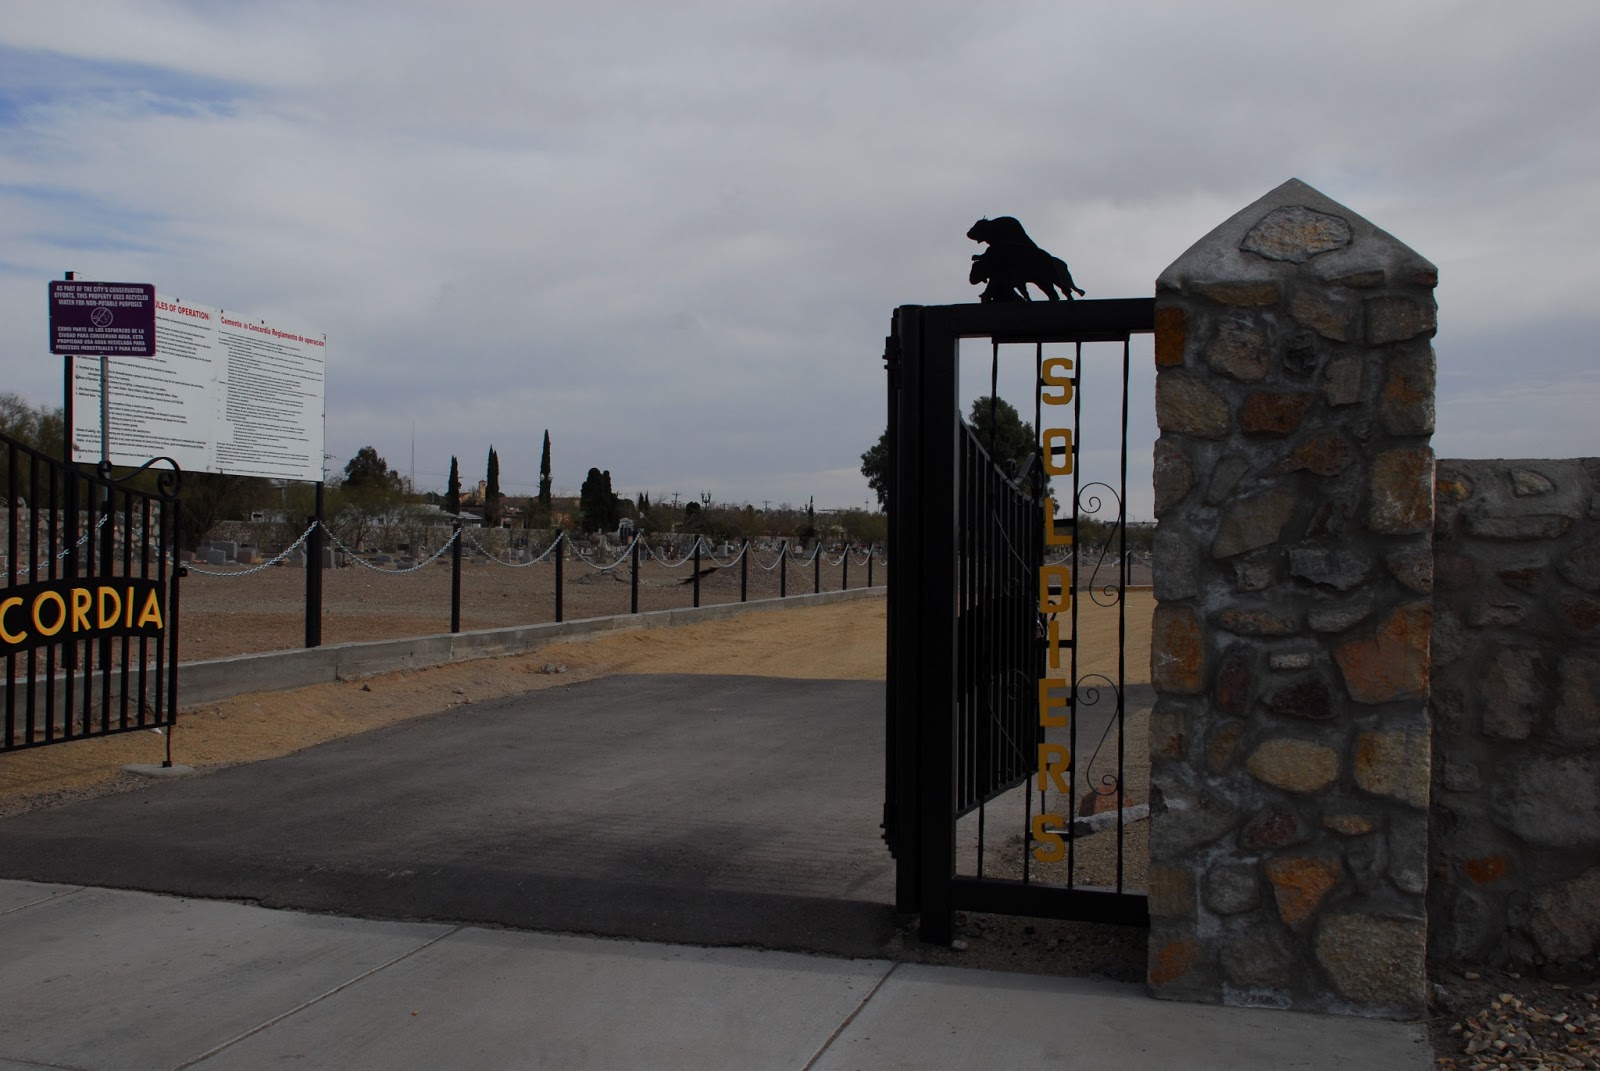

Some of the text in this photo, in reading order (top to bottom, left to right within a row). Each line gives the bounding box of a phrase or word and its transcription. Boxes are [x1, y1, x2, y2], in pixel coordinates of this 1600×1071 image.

[169, 304, 176, 312] OF
[178, 306, 209, 320] OPERATION
[249, 323, 271, 334] Concordia
[1032, 357, 1073, 864] SOLDIERS
